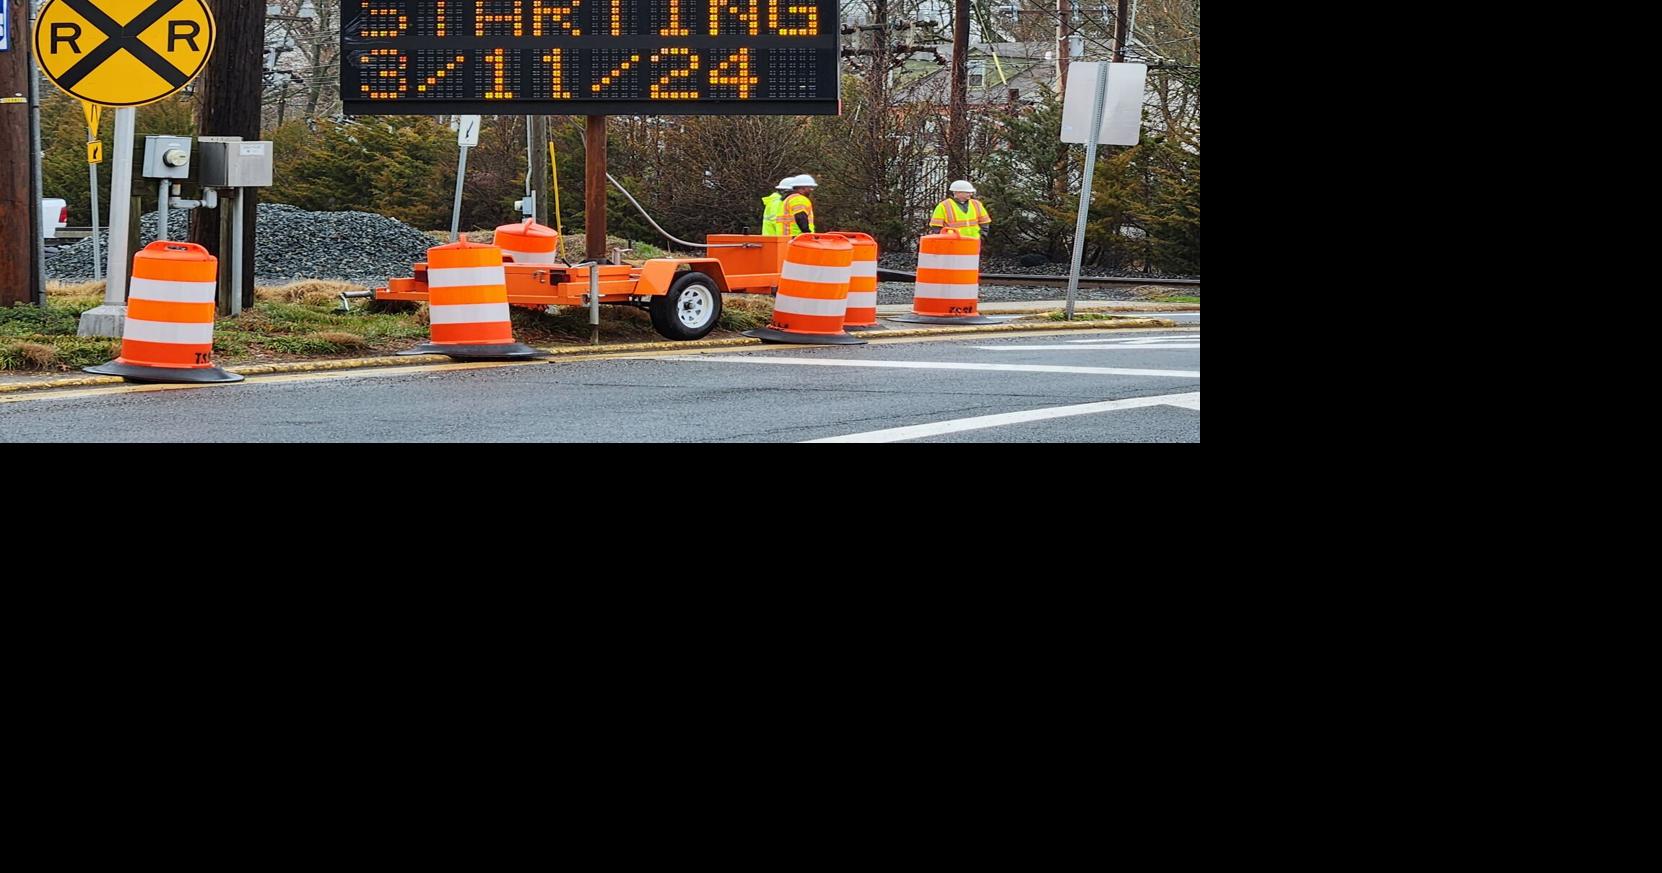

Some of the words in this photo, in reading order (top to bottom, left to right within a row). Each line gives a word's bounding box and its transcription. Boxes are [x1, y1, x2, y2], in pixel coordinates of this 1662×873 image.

[50, 22, 82, 54] R
[167, 20, 201, 52] R
[360, 0, 818, 37] STARTING
[360, 48, 759, 99] 3/11/24
